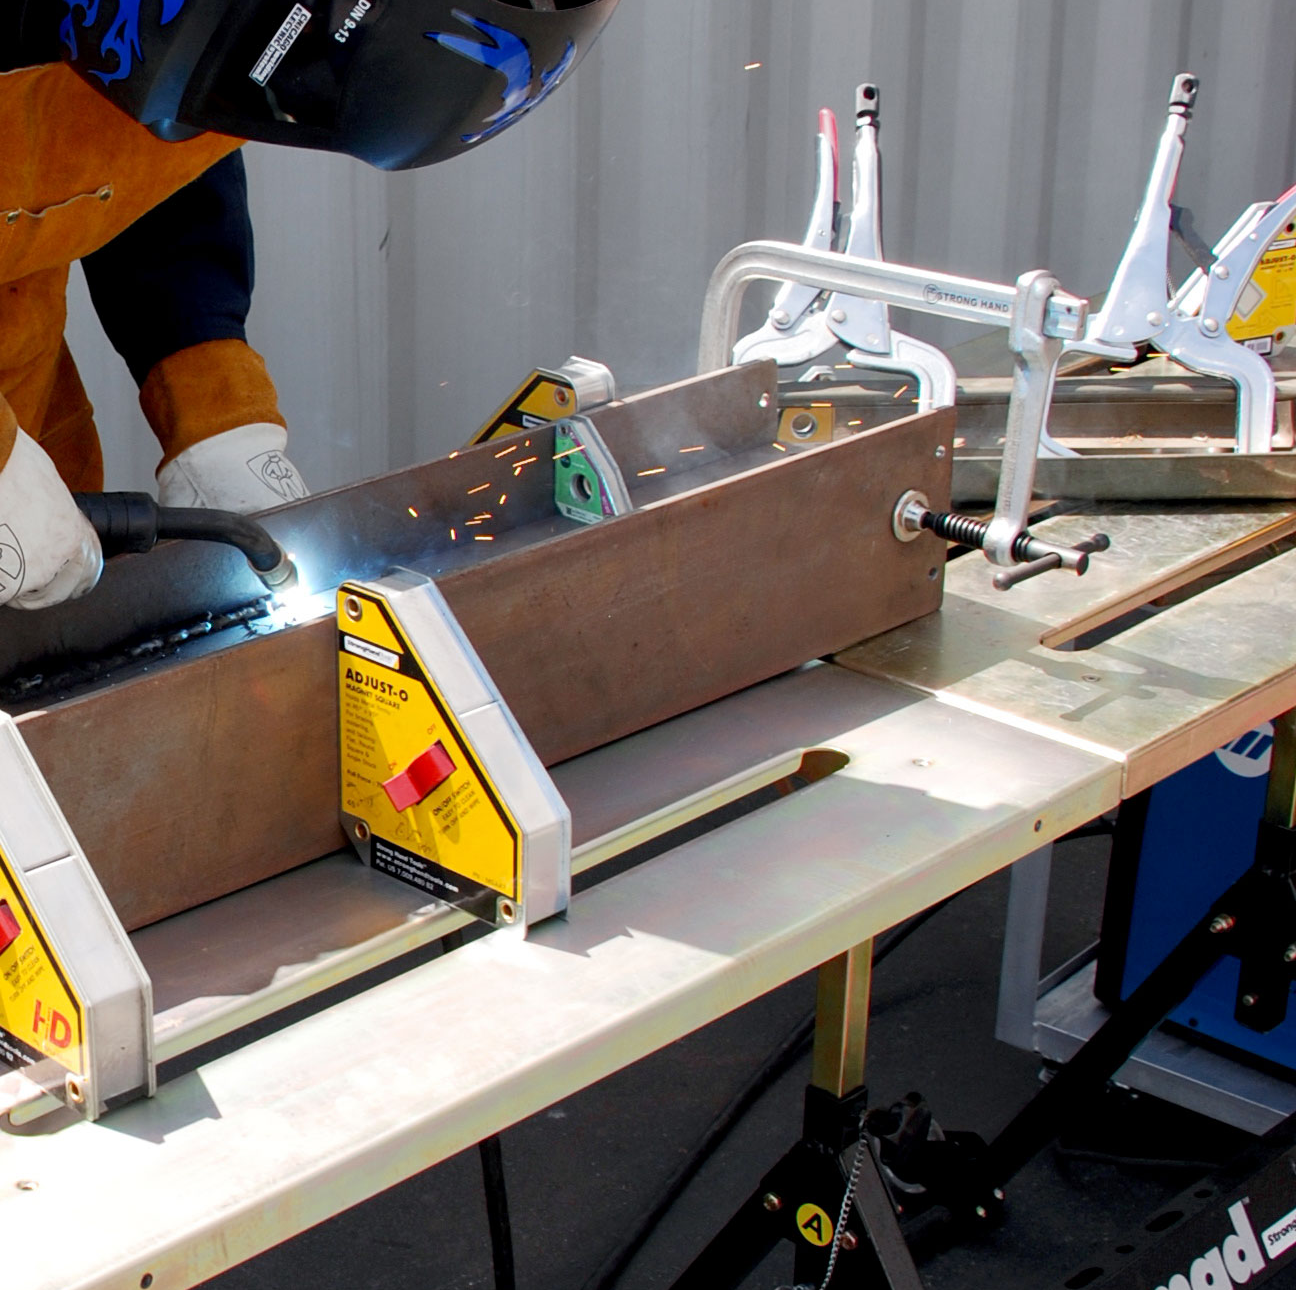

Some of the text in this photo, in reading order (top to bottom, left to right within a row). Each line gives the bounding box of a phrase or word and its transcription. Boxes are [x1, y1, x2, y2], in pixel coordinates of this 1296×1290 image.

[273, 6, 303, 47] ELECTRIC
[279, 13, 308, 51] CHICAGO
[334, 17, 357, 43] 9-13
[936, 291, 1010, 313] STRONG HAND
[345, 667, 409, 702] ADJUST-O
[801, 1213, 824, 1242] A
